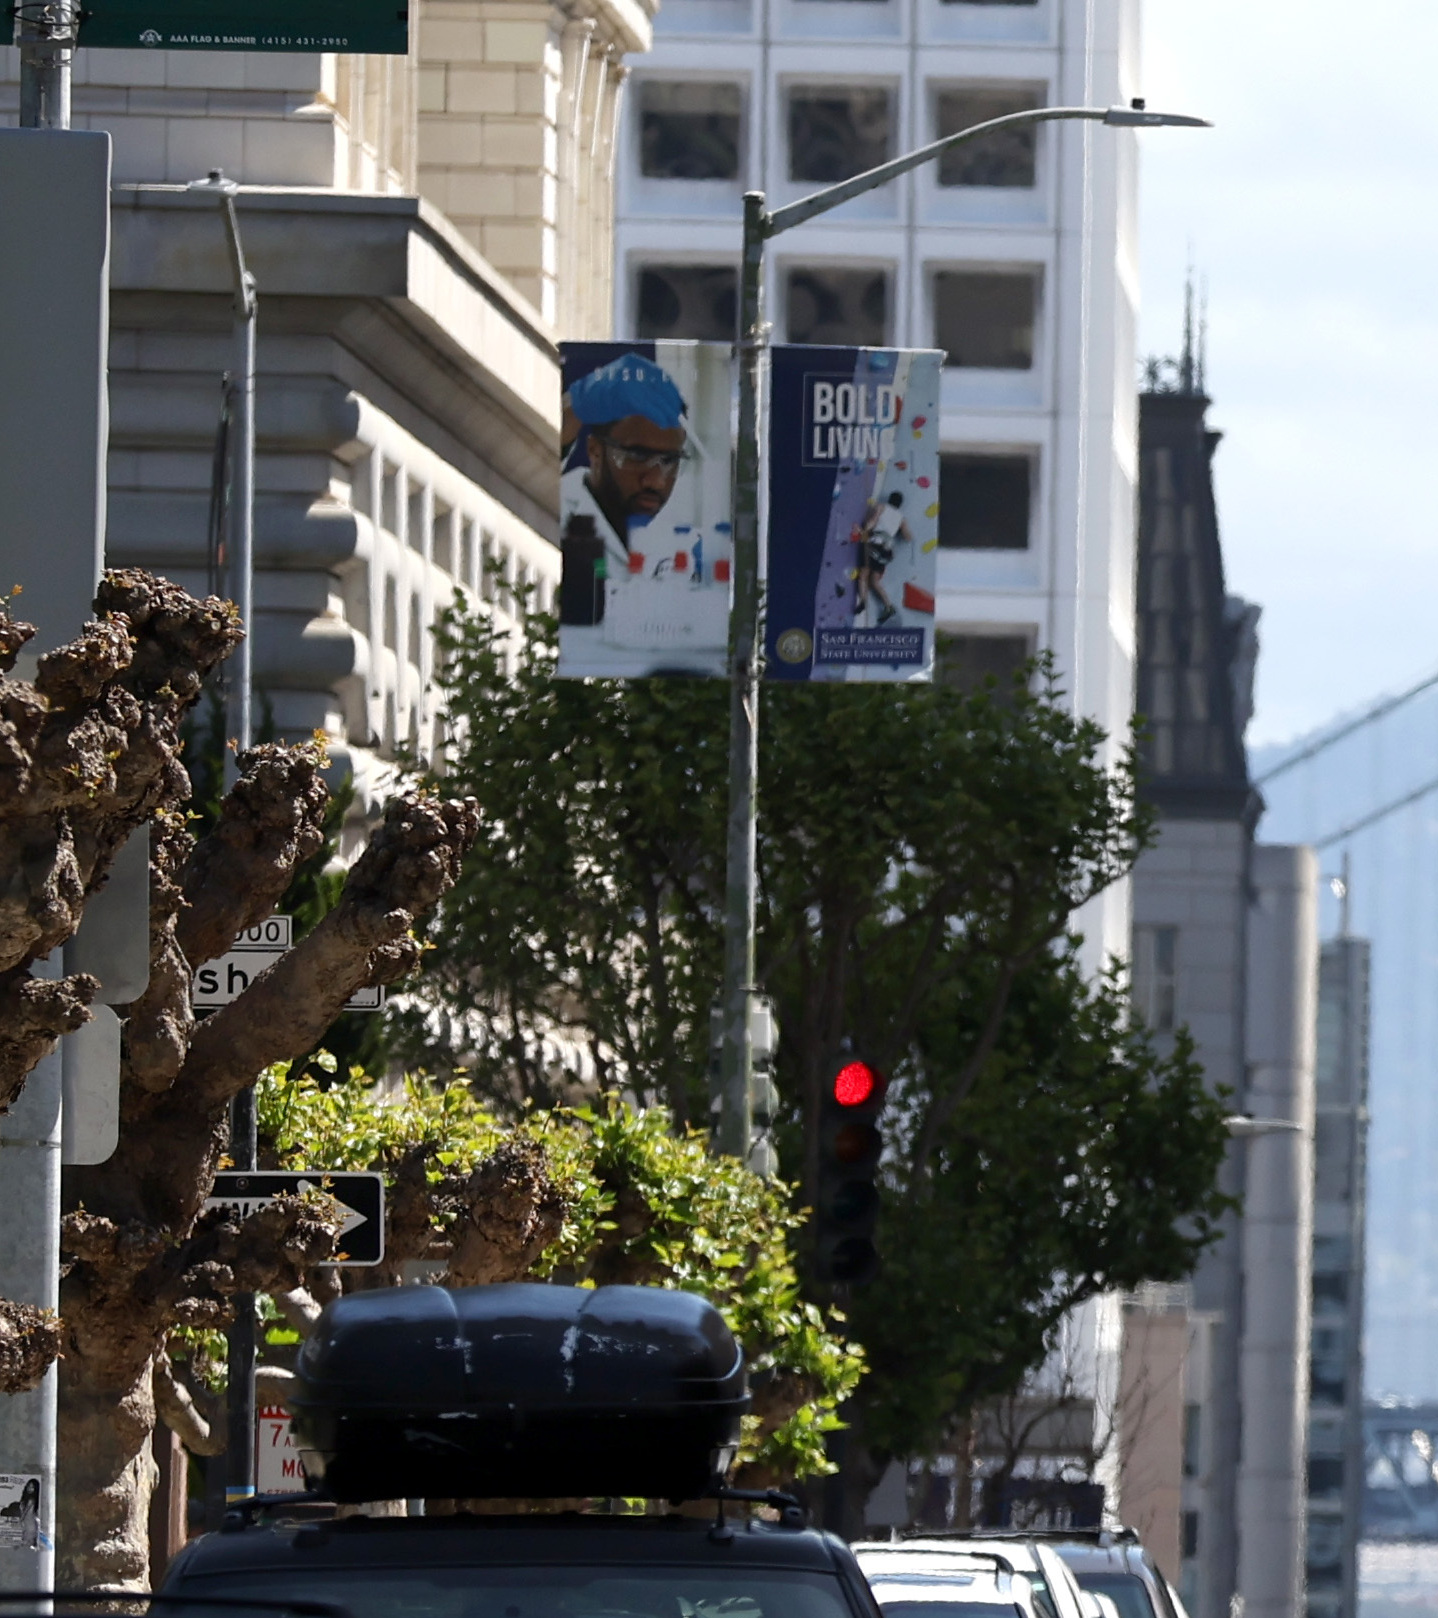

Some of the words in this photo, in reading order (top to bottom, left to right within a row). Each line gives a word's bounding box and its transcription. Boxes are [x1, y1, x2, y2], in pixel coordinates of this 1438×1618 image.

[170, 35, 188, 43] AAA
[214, 35, 221, 43] &
[223, 36, 256, 44] BANNER
[813, 383, 895, 424] BOLD
[813, 427, 894, 458] LIVING
[850, 632, 919, 644] FRANCISCO
[270, 1424, 283, 1447] 7
